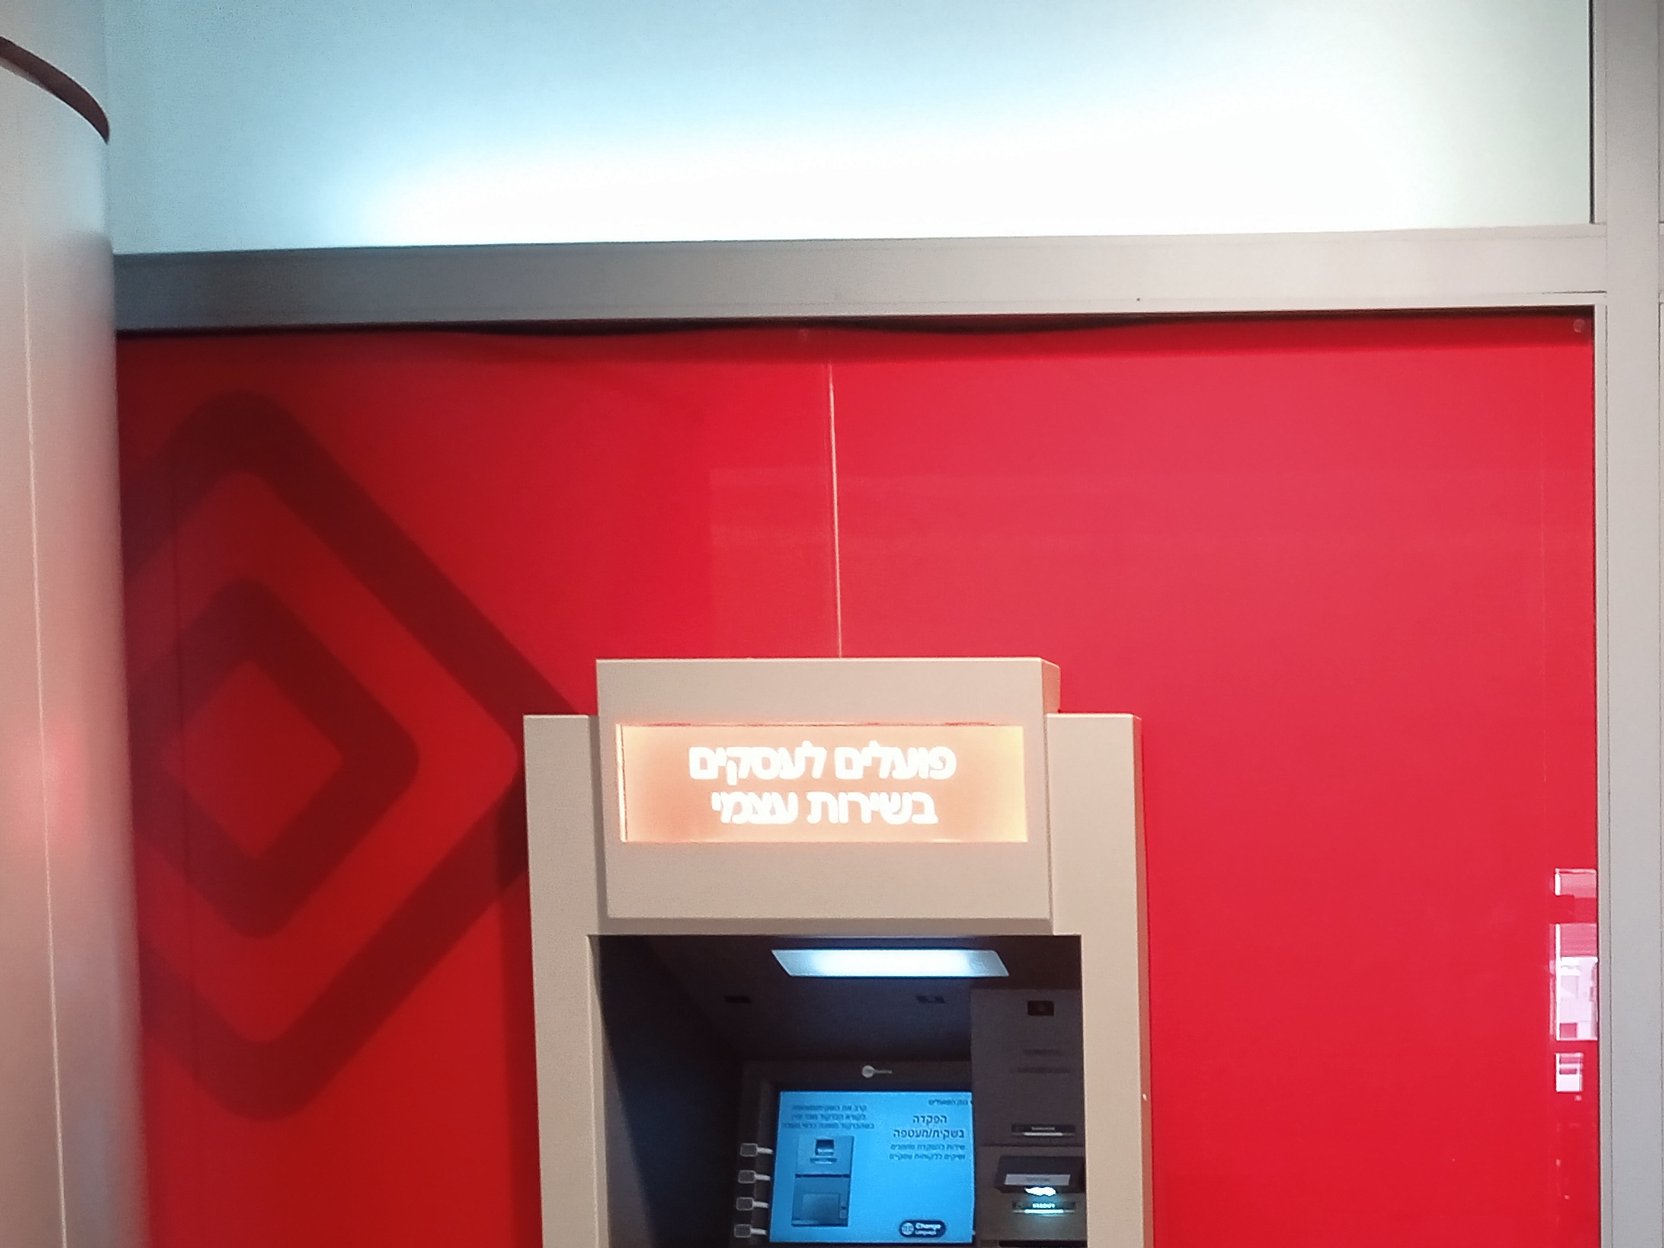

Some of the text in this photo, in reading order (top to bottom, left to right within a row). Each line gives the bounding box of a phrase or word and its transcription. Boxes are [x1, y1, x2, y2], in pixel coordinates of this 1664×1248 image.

[688, 740, 957, 786] פועלים לעסקים
[711, 790, 938, 825] בשירות עצמי
[912, 1115, 948, 1126] הפקדה
[893, 1129, 965, 1140] בשקית/מעטפה
